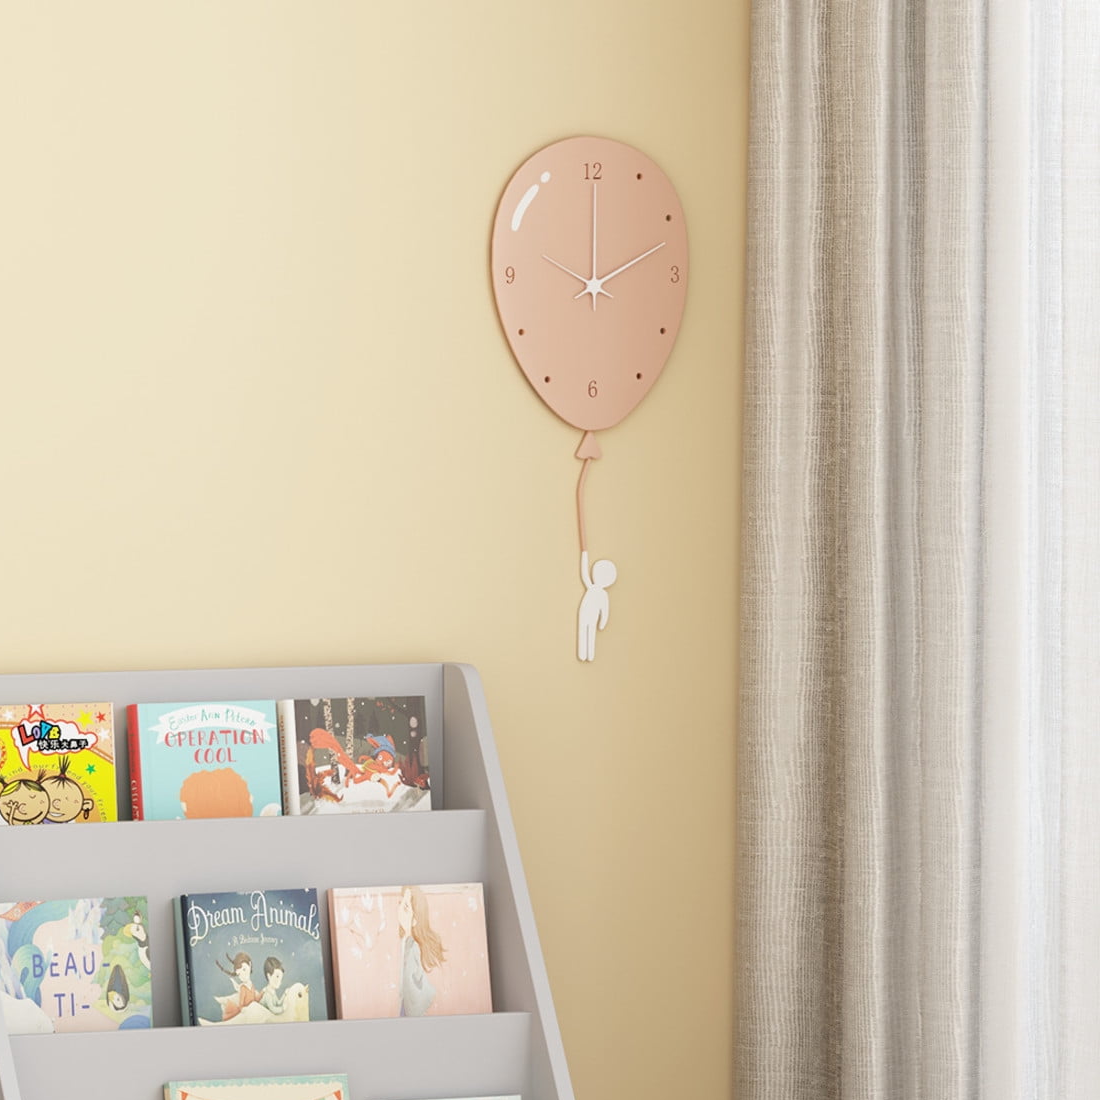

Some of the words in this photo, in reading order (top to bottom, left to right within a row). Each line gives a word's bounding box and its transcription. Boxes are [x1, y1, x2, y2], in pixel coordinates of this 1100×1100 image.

[583, 162, 602, 180] 12
[505, 266, 515, 284] 9
[670, 265, 680, 283] 3
[587, 380, 598, 398] 6
[164, 729, 265, 747] OPERATION
[194, 747, 237, 764] COOL
[187, 900, 247, 947] Dream
[250, 890, 320, 940] Animals
[53, 993, 90, 1017] TI-
